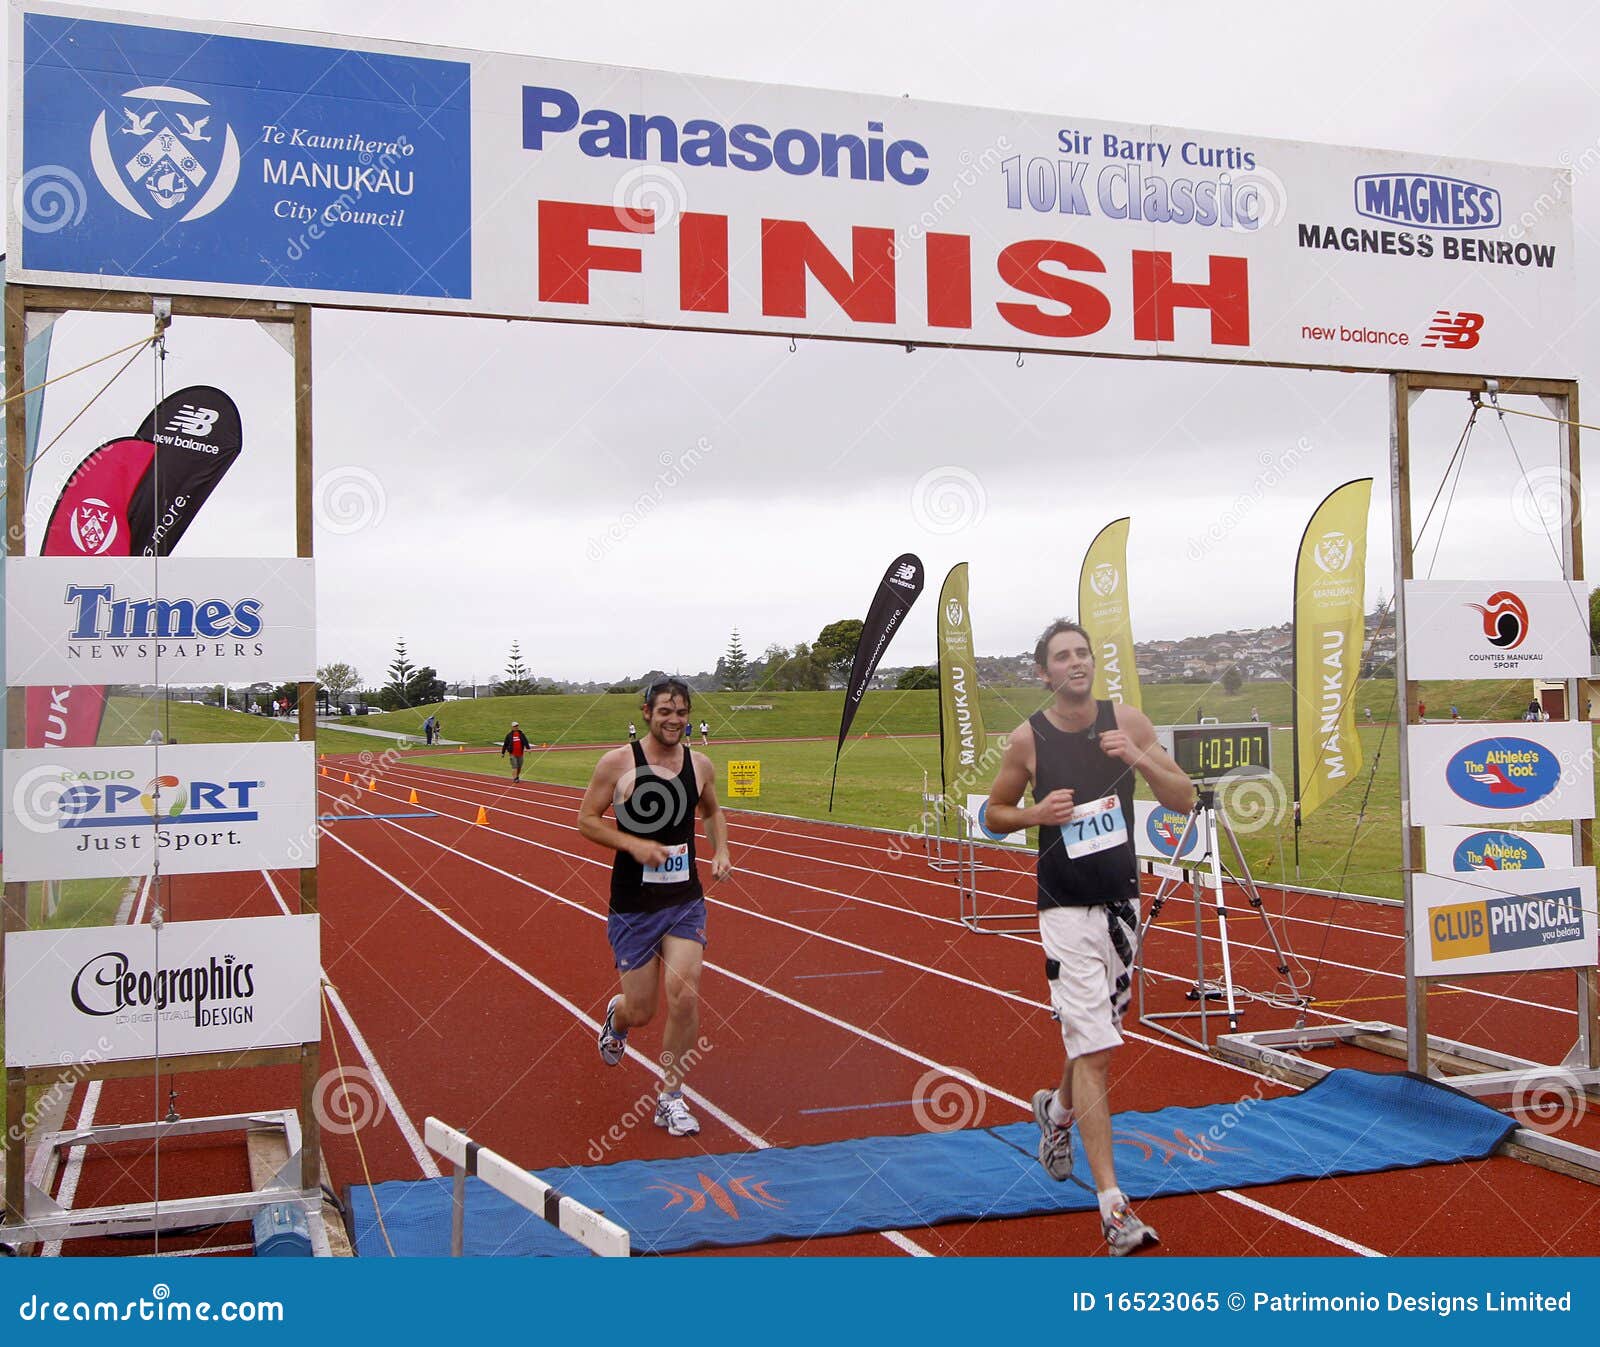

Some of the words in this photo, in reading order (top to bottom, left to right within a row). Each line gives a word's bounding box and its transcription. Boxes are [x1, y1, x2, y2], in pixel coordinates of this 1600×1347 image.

[262, 125, 286, 145] Te
[289, 127, 397, 156] Kaunihera
[521, 85, 930, 187] Panasonic
[1057, 129, 1093, 156] Sir
[1103, 133, 1172, 168] Barry
[1181, 142, 1257, 172] Curtis
[262, 158, 415, 196] MANUKAU
[1001, 154, 1093, 217] 10K
[1097, 162, 1260, 231] Classic
[273, 200, 318, 224] City
[324, 203, 405, 227] Council
[1364, 177, 1493, 225] MAGNESS
[1297, 223, 1435, 259] MAGNESS
[1442, 236, 1556, 269] BENROW
[538, 199, 1250, 347] FINISH
[1301, 325, 1336, 341] new
[1340, 325, 1410, 346] balance
[152, 432, 175, 445] new
[173, 434, 220, 456] balance
[151, 494, 192, 544] more.
[64, 583, 265, 641] Times
[67, 642, 265, 659] NEWSPAPERS
[1468, 653, 1506, 662] COUNTIES
[1507, 653, 1543, 661] MANUKAU
[1493, 661, 1519, 669] SPORT
[1102, 642, 1124, 705] UKAU
[953, 667, 976, 766] MANUKAU
[1319, 630, 1347, 780] MANUKAU
[59, 769, 136, 782] RADIO
[1463, 760, 1485, 774] The
[1485, 750, 1540, 766] Athlete's
[77, 832, 142, 851] Just
[156, 828, 242, 851] Sport.
[1071, 812, 1115, 841] 710
[655, 856, 683, 873] 09
[1466, 850, 1483, 864] The
[1483, 843, 1528, 860] Athlete's
[1434, 909, 1484, 942] CLUB
[1490, 895, 1580, 935] PHYSICAL
[1542, 929, 1556, 942] you
[1556, 925, 1581, 940] belong
[70, 951, 255, 1028] Cleographics
[115, 1009, 197, 1025] DIGITAL
[200, 1005, 254, 1027] DESIGN
